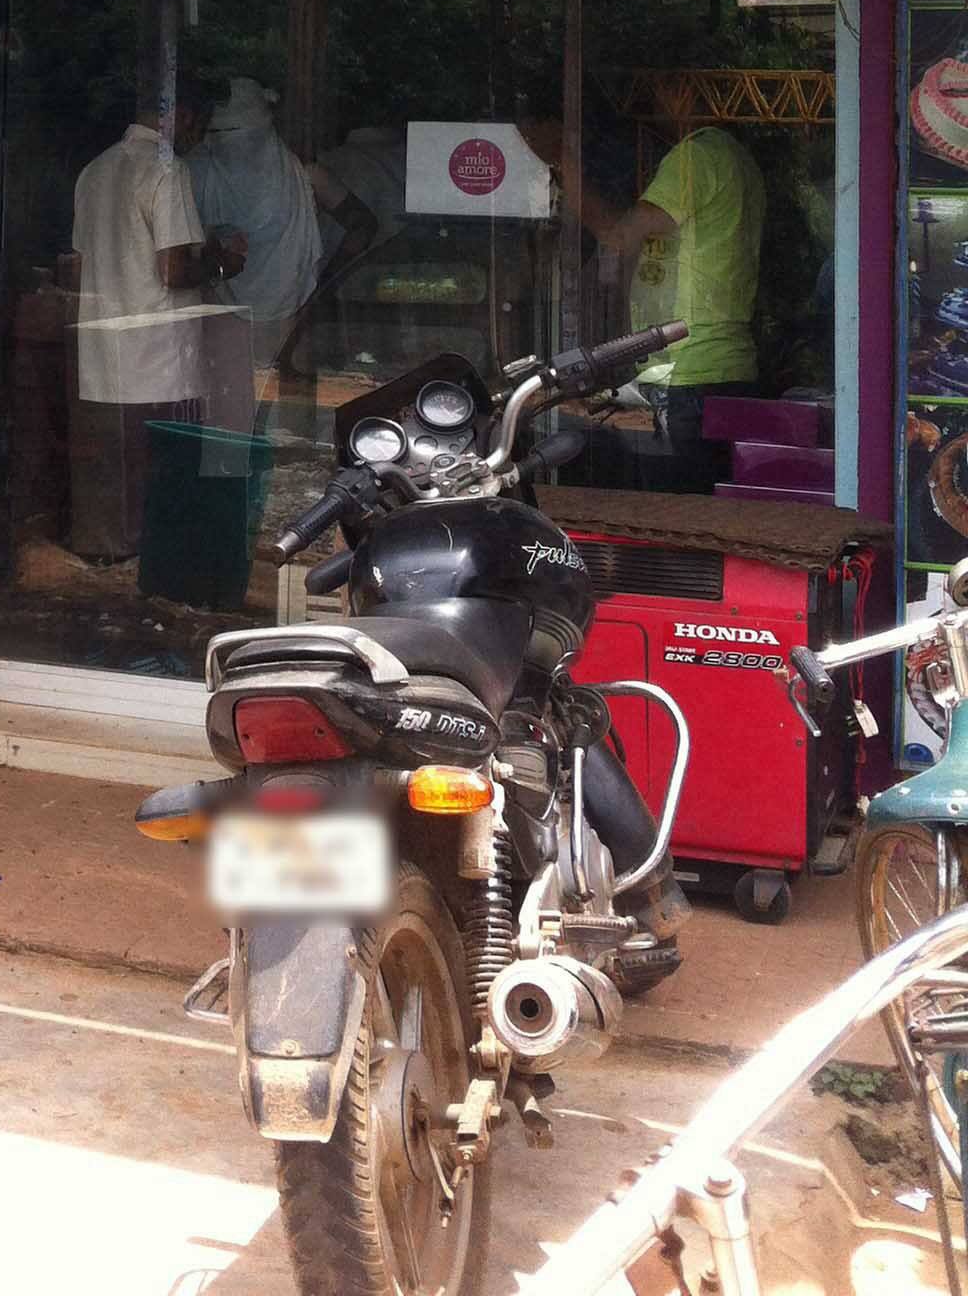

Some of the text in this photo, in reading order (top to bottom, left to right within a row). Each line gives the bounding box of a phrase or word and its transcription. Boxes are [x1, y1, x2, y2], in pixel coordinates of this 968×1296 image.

[457, 165, 498, 176] amore
[464, 153, 489, 165] mio
[673, 622, 781, 646] HONDA
[703, 649, 783, 672] 2800
[395, 707, 432, 732] 150
